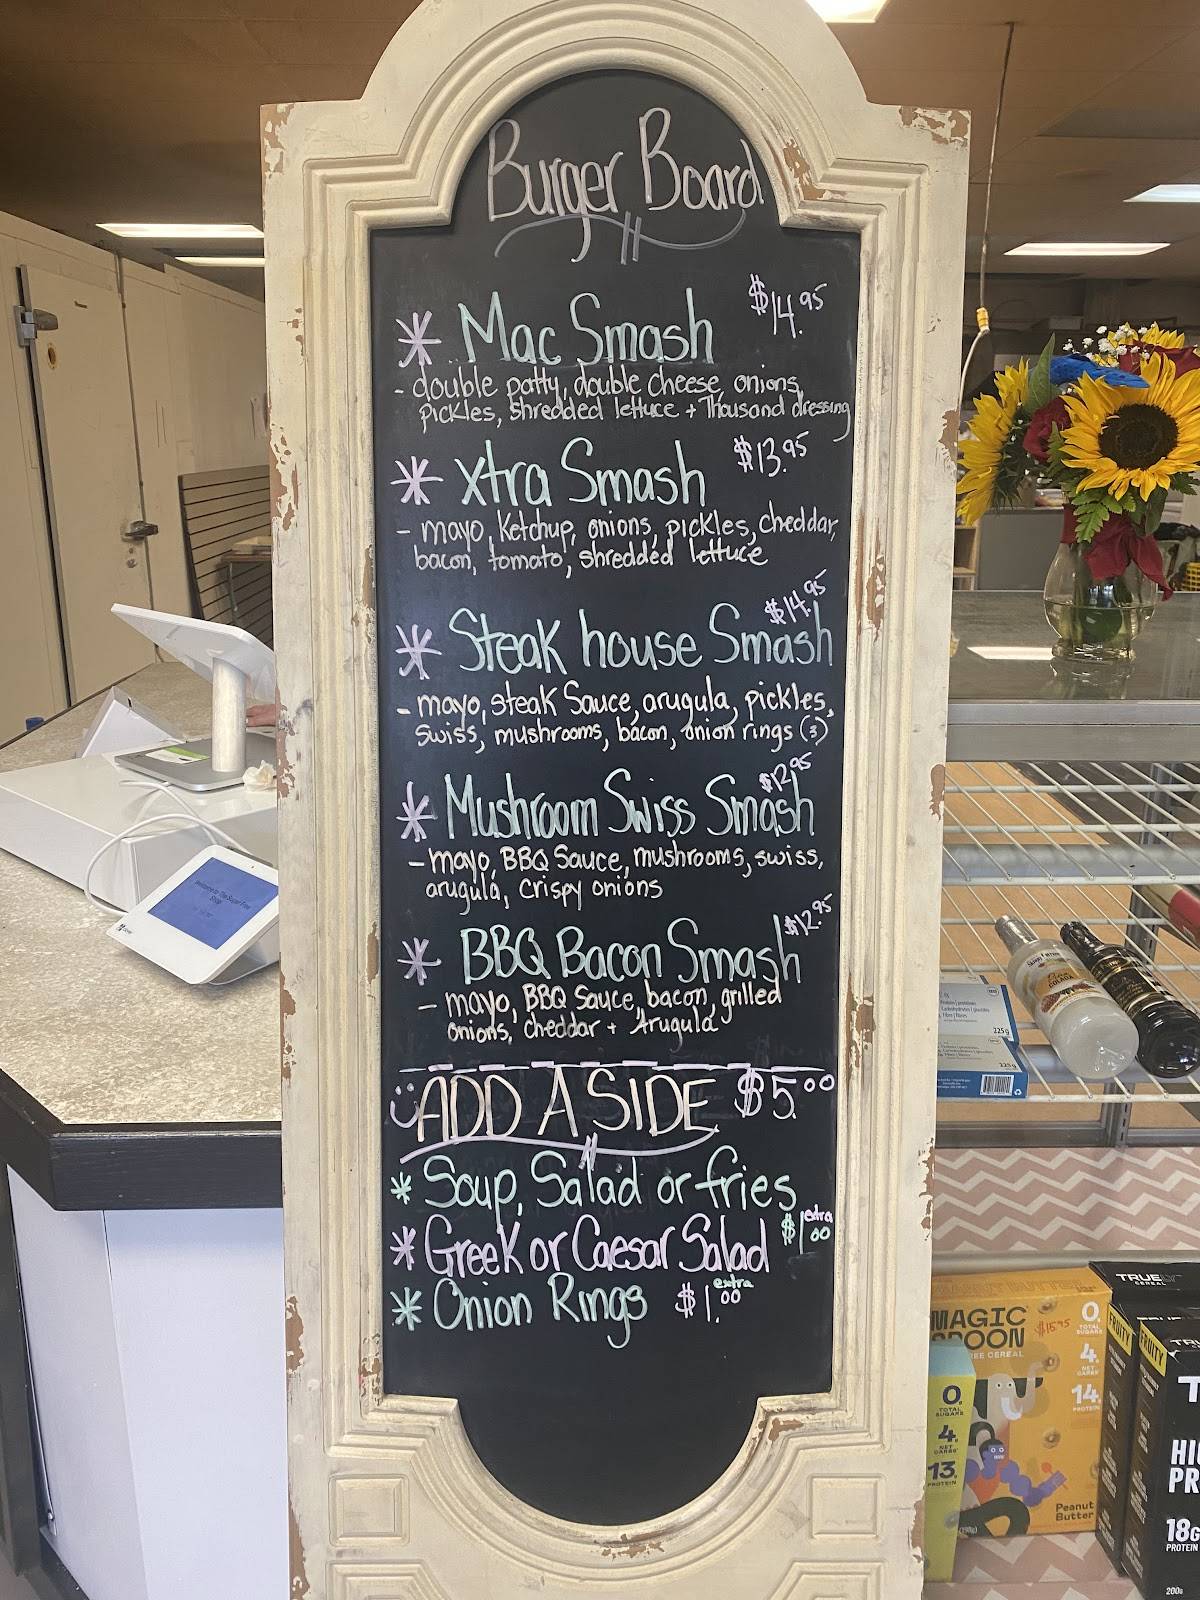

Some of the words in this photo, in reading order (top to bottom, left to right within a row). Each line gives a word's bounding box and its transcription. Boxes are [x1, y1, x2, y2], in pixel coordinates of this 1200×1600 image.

[488, 118, 624, 263] Burger
[639, 107, 764, 211] Board
[457, 291, 561, 364] Mac
[570, 287, 714, 366] Smash
[412, 365, 498, 402] double
[506, 366, 567, 402] patty,
[574, 364, 641, 398] double
[509, 396, 604, 421] shredded
[615, 395, 679, 420] lettuce
[698, 393, 784, 419] Thousand
[792, 392, 850, 442] dressing
[560, 437, 706, 507] Smash
[421, 520, 492, 552] mayo,
[587, 511, 657, 548] onions,
[759, 499, 839, 542] cheddar,
[413, 544, 477, 576] bacon,
[487, 543, 572, 579] tomato,
[578, 540, 673, 569] shredded
[689, 537, 768, 566] lettuce
[449, 607, 567, 675] Steak
[579, 608, 702, 671] house
[709, 600, 833, 667] Smash
[417, 694, 486, 729] mayo,
[495, 718, 609, 752] mushrooms,
[616, 716, 676, 750] bacon,
[683, 718, 735, 741] onion
[742, 722, 793, 752] rings
[800, 715, 829, 746] (3)
[444, 772, 599, 840] Mushroom
[604, 767, 696, 838] Swiss
[705, 769, 814, 838] Smash
[428, 848, 496, 884] mayo,
[500, 845, 549, 872] BBQ
[633, 840, 752, 878] mushrooms,
[425, 871, 510, 915] arugula,
[591, 874, 664, 899] onions
[460, 923, 551, 985] BBQ
[555, 925, 662, 982] Bacon
[667, 914, 801, 984] Smash
[444, 990, 518, 1025] mayo,
[522, 983, 566, 1012] BBQ
[721, 978, 782, 1025] grilled
[448, 1020, 512, 1046] onions,
[524, 1011, 601, 1039] cheddar
[417, 1074, 522, 1142] ADD
[537, 1066, 579, 1137] A
[588, 1067, 717, 1137] SIDE
[423, 1155, 523, 1224] Soup,
[530, 1150, 642, 1208] Salad
[657, 1172, 692, 1205] or
[695, 1145, 797, 1211] fries
[804, 1203, 833, 1223] extra
[424, 1214, 524, 1278] Greek
[529, 1231, 568, 1272] or
[572, 1214, 676, 1272] Caesar
[679, 1213, 770, 1273] Salad
[713, 1273, 754, 1288] extra
[434, 1277, 532, 1332] Onion
[547, 1271, 647, 1349] Rings
[930, 1306, 1027, 1330] MAGIC
[1109, 1312, 1131, 1347] FRUITY
[1141, 1327, 1164, 1367] FRUITY
[1056, 1501, 1094, 1512] Peanut
[1056, 1511, 1094, 1521] Butter
[1166, 1543, 1199, 1552] PROTEIN
